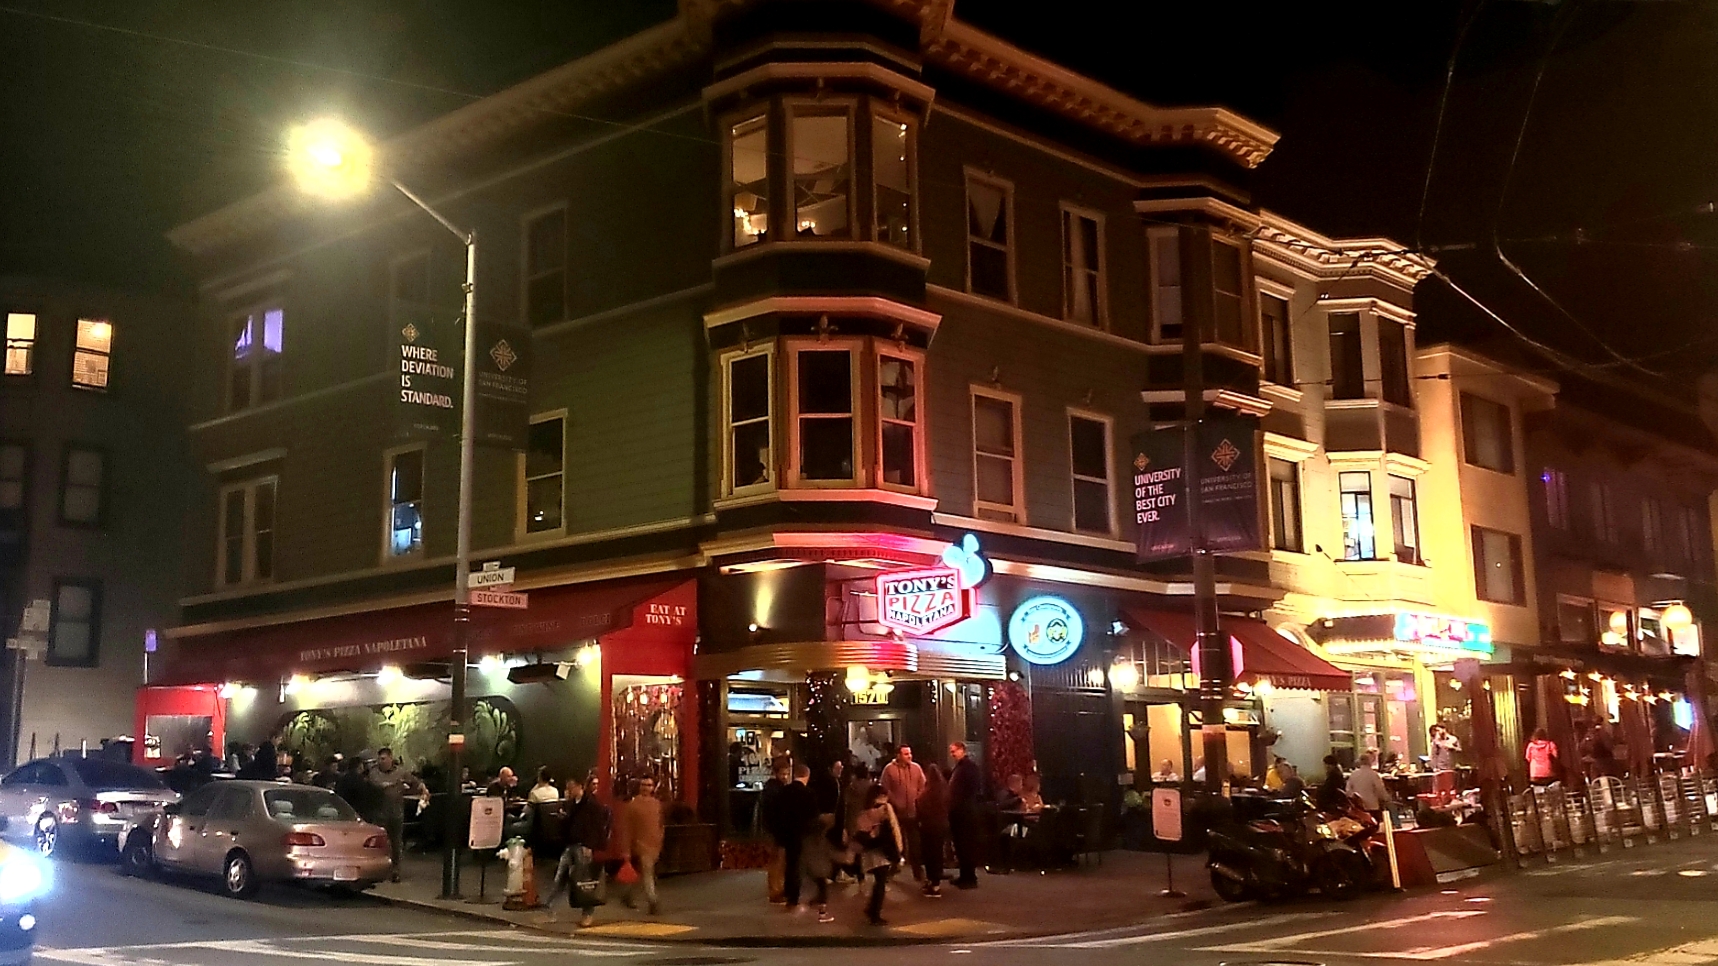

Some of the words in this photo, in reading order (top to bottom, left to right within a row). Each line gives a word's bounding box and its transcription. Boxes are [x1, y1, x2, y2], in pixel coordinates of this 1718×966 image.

[401, 345, 438, 362] WHERE
[401, 360, 454, 379] DEVIATION
[401, 375, 411, 388] IS
[401, 389, 454, 409] STANDARD.
[1134, 468, 1181, 486] UNIVERSITY
[1200, 474, 1241, 485] UNIVERSITY
[1243, 472, 1251, 480] OF
[1135, 486, 1147, 499] OF
[1147, 483, 1164, 496] THE
[1215, 481, 1253, 492] FRANCISCO
[1136, 497, 1156, 511] BEST
[1157, 494, 1176, 508] CITY
[1136, 510, 1161, 524] EVER.
[477, 573, 505, 584] UNION
[886, 575, 955, 595] TONY'S
[477, 593, 521, 605] STOCKTON
[889, 592, 954, 614] PIZZA
[650, 603, 670, 615] EAT
[674, 605, 687, 616] AT
[889, 603, 955, 627] NAPOLETANA
[645, 613, 683, 626] TONY'S
[334, 644, 361, 658] PIZZA
[364, 636, 427, 654] NAPOLETANA
[1288, 676, 1311, 687] PIZZA
